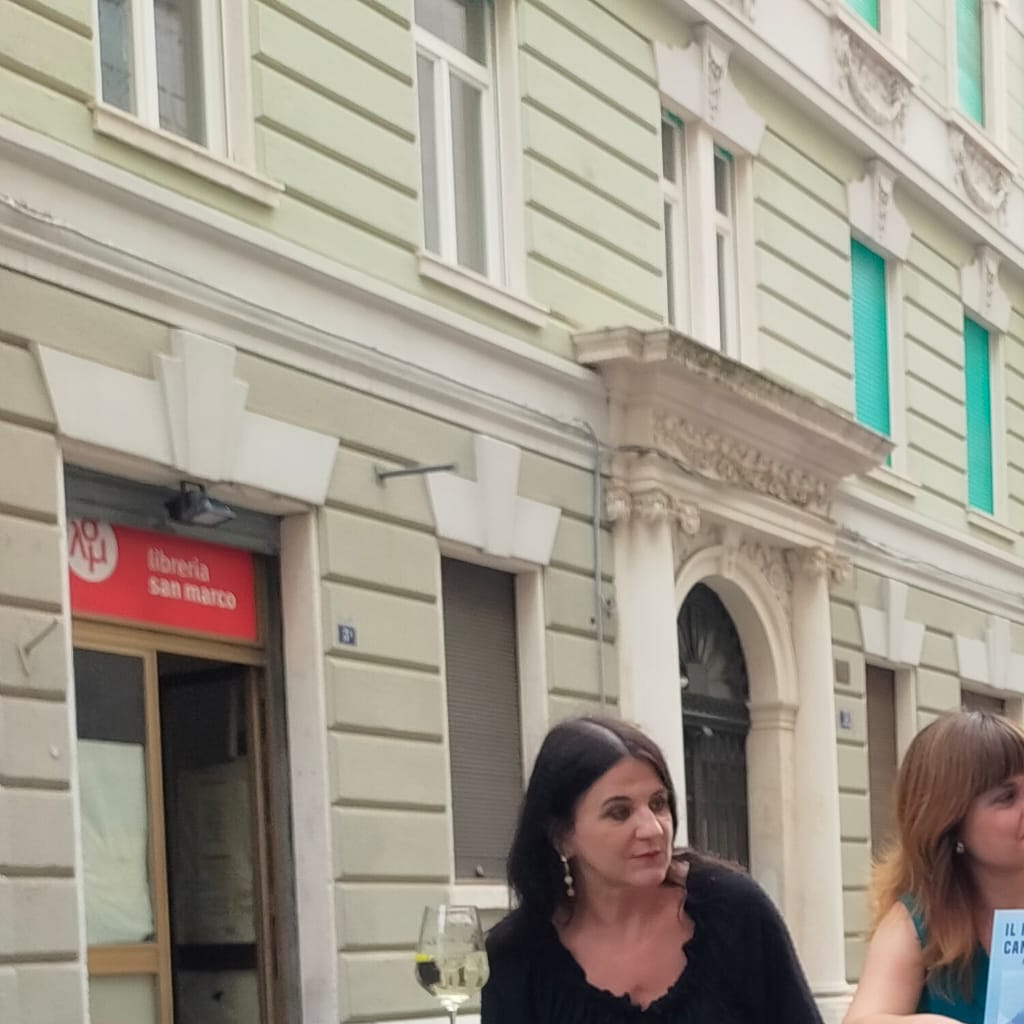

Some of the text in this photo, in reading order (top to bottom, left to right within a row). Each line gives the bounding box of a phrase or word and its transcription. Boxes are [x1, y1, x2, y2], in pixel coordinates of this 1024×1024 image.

[147, 547, 210, 583] libreria
[148, 575, 237, 611] san marco
[1005, 922, 1016, 937] IL
